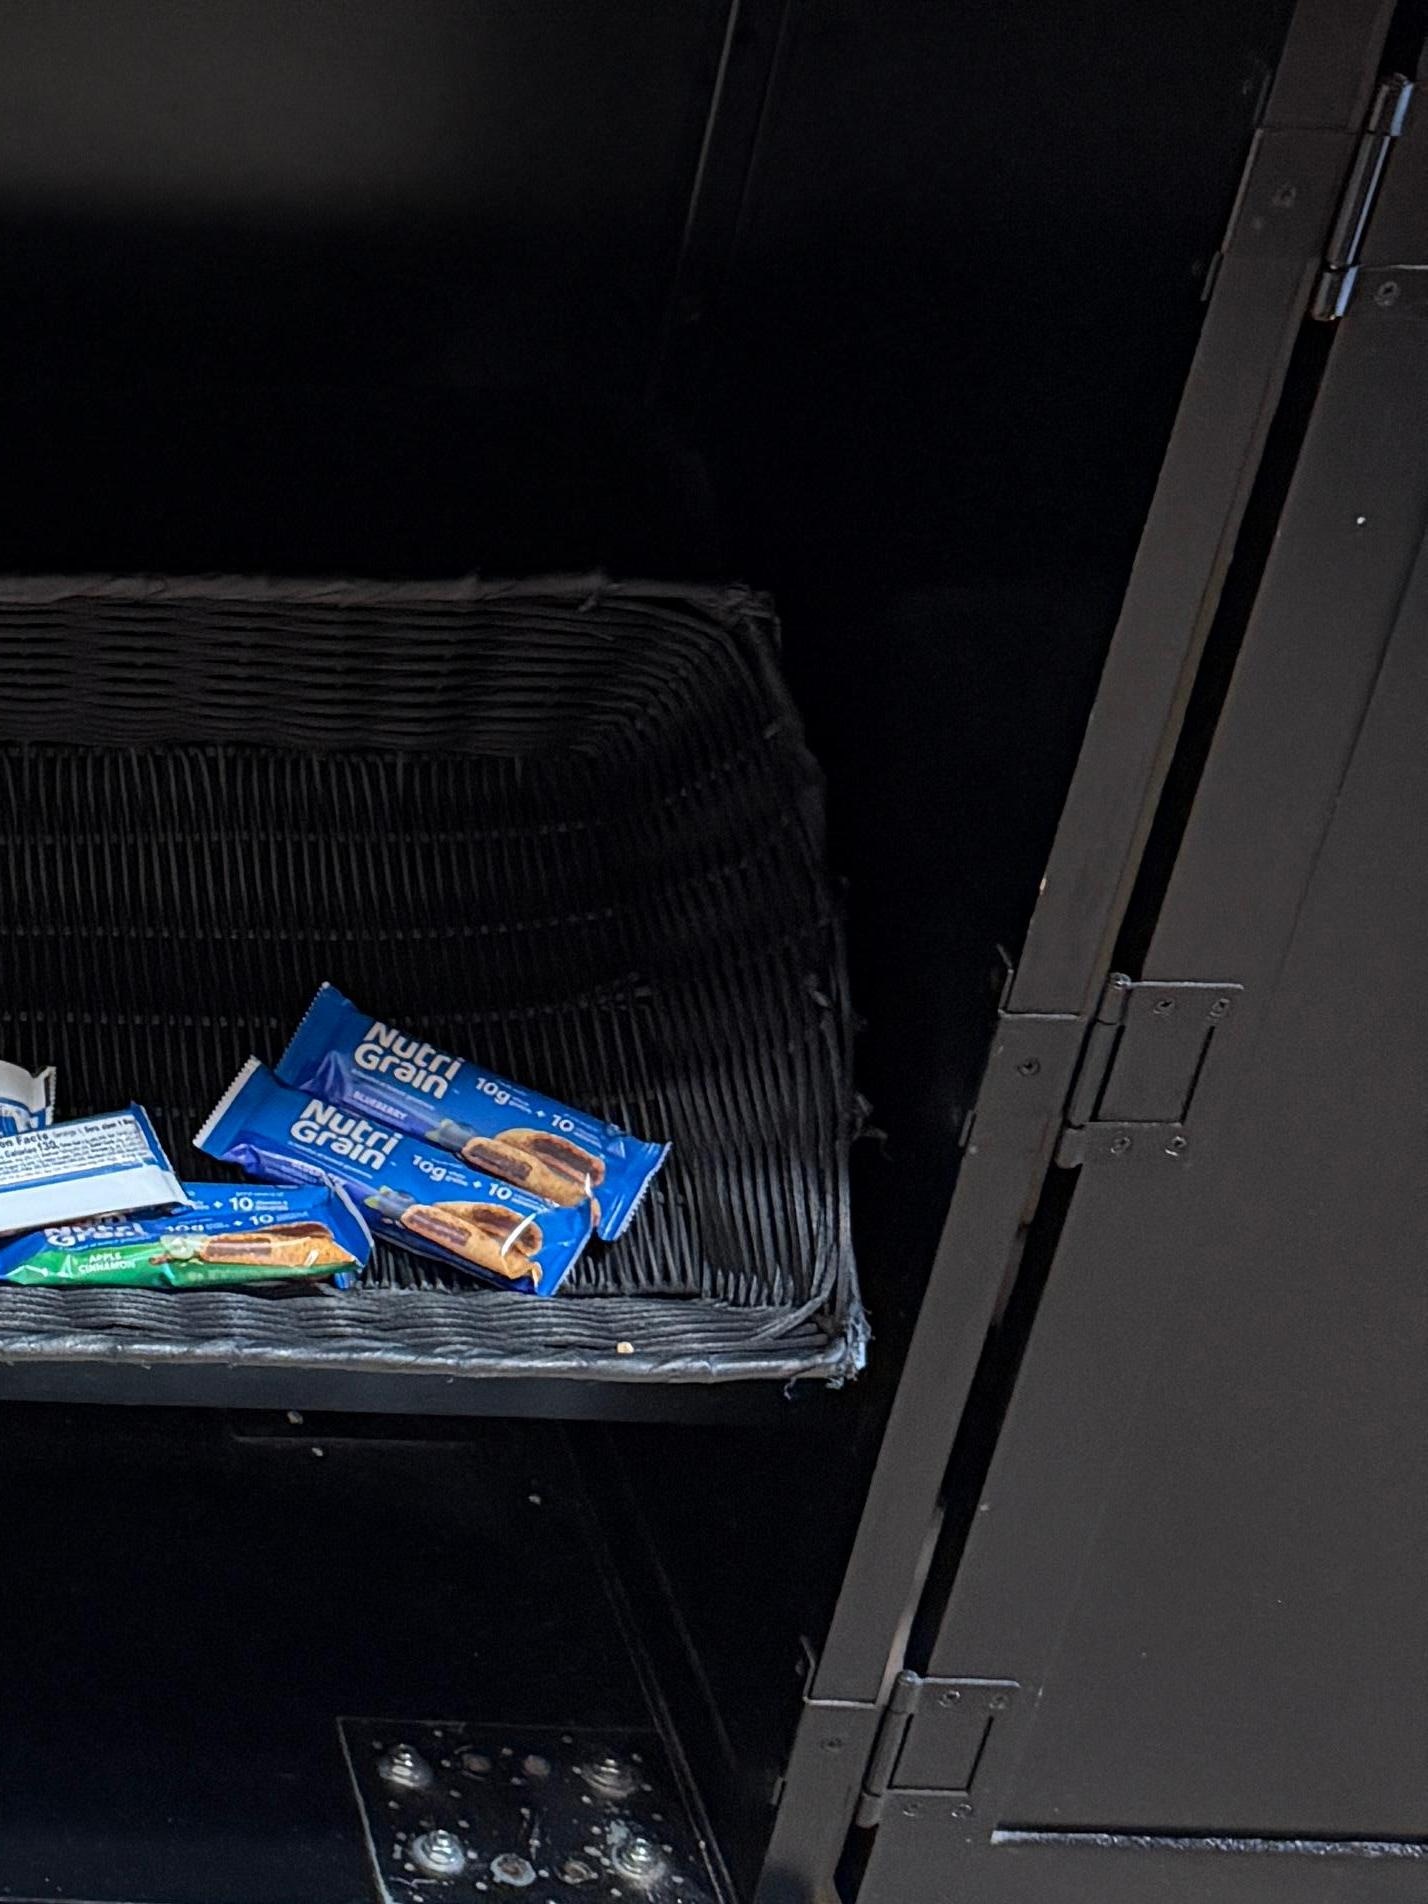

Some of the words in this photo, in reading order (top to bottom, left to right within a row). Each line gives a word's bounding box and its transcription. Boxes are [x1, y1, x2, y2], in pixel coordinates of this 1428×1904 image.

[353, 1043, 450, 1099] Grain
[364, 1021, 465, 1081] Nutri
[299, 1098, 403, 1156] Nutri
[475, 1077, 511, 1105] 10g
[550, 1114, 575, 1133] 10
[16, 1130, 48, 1146] Facts
[290, 1119, 387, 1171] Grain
[413, 1154, 447, 1182] 10g
[488, 1182, 513, 1200] 10
[229, 1196, 254, 1212] 10
[77, 1261, 137, 1275] CINNAMON
[88, 1252, 122, 1264] APPLE
